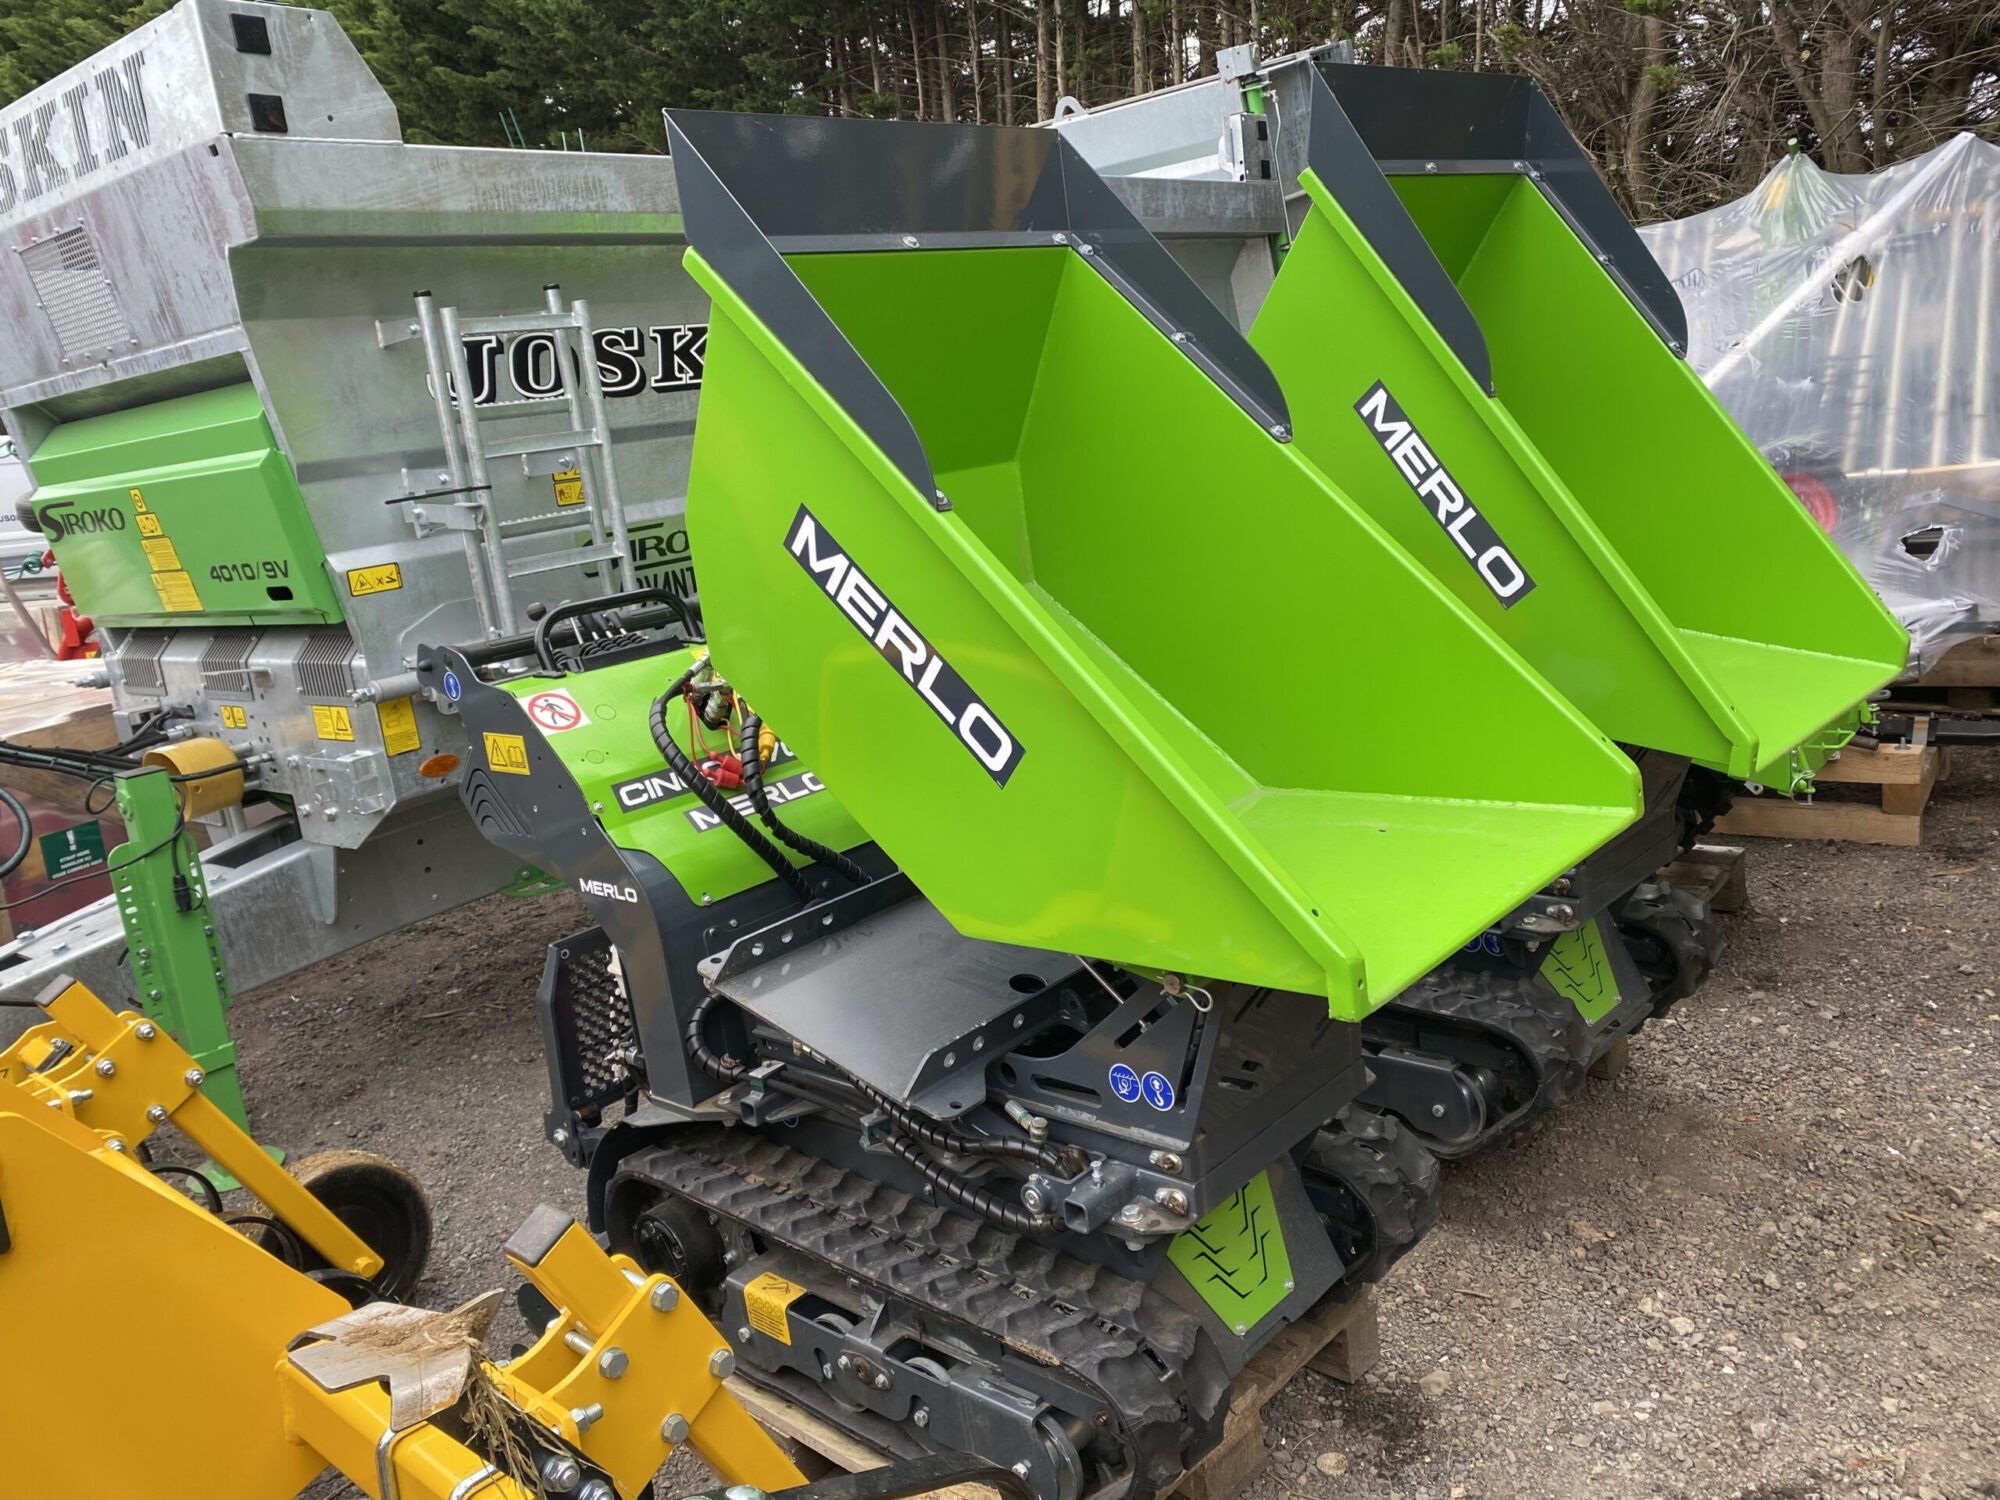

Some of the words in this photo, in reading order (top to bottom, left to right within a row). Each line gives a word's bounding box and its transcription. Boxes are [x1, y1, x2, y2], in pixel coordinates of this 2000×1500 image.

[1359, 388, 1526, 598] MERLO
[39, 501, 126, 543] SIROKO
[210, 559, 289, 583] 4010/9V
[790, 514, 1013, 772] MERLO
[579, 878, 638, 903] MERLO
